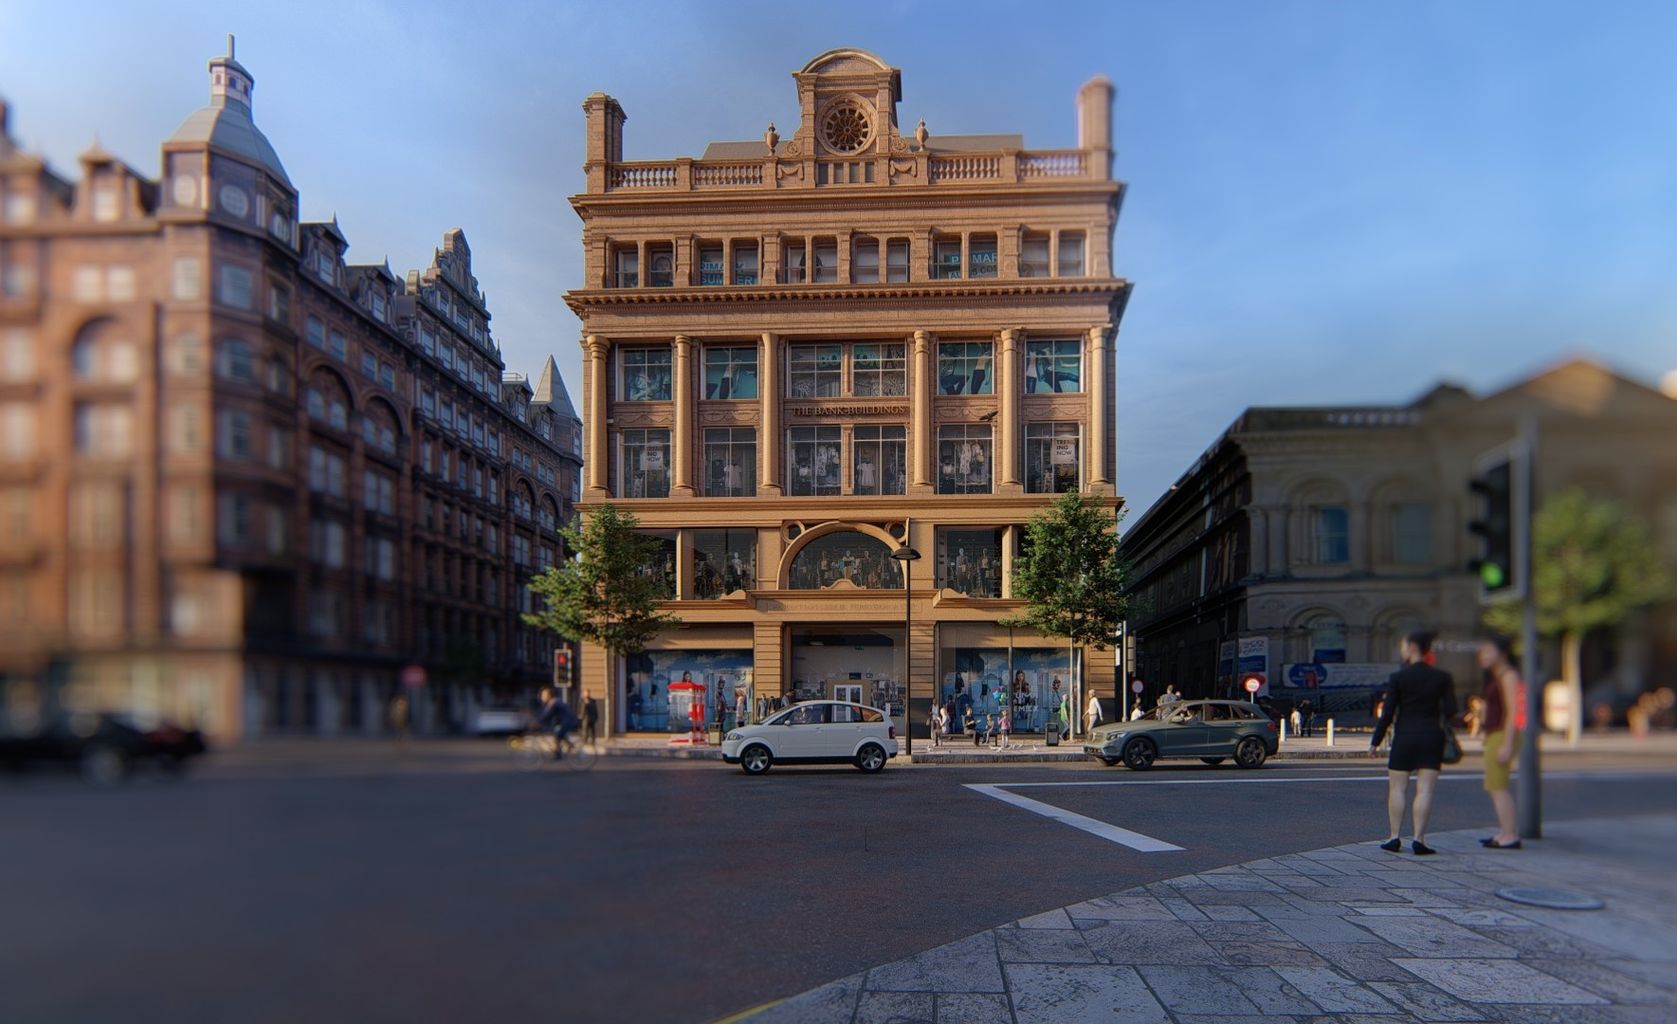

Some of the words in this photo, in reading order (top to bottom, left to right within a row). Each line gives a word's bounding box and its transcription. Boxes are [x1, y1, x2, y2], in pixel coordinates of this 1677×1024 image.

[793, 407, 812, 415] THE
[815, 407, 843, 415] BANK
[848, 406, 905, 414] BUILDINGS
